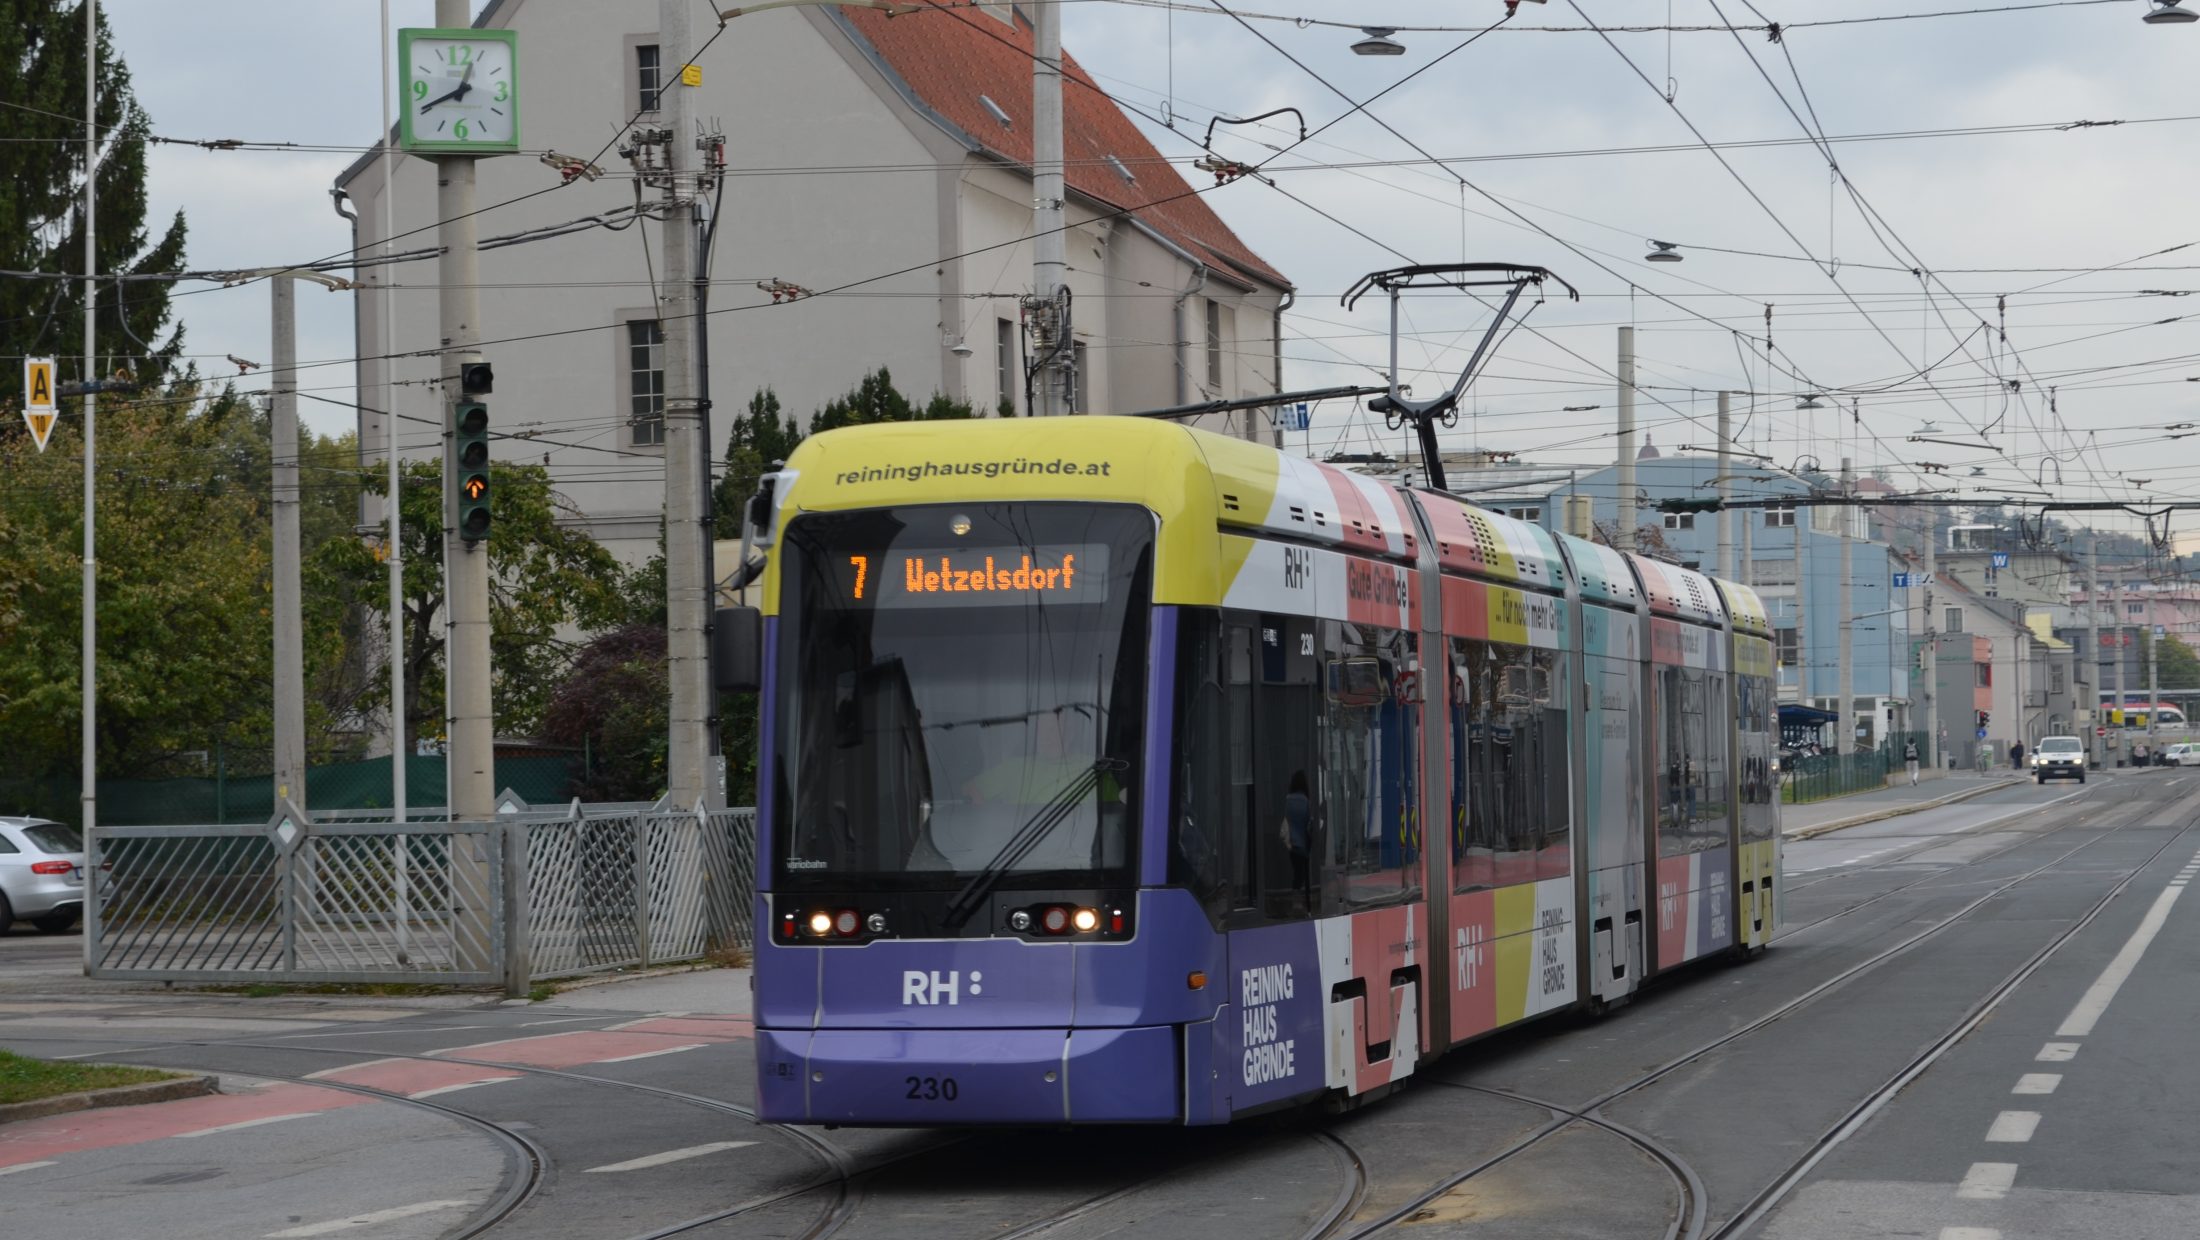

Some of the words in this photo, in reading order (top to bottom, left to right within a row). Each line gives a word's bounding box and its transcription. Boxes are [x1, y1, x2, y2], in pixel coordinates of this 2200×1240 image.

[447, 45, 473, 66] 12
[413, 80, 429, 101] 9
[494, 81, 508, 102] 3
[453, 118, 469, 139] 6
[33, 368, 49, 400] A
[36, 415, 46, 432] 10
[836, 459, 1111, 485] reininghausgründe.at
[1993, 555, 2007, 567] W
[850, 556, 867, 599] 7
[905, 554, 1074, 592] Wetzelsdorf
[1349, 560, 1371, 602] Gute
[1374, 566, 1407, 608] Gründe
[1896, 576, 1905, 585] T
[1531, 597, 1547, 630] mehr
[1301, 633, 1314, 656] 230
[1542, 907, 1563, 938] REINING
[1543, 937, 1557, 966] HAUS
[1242, 963, 1294, 1007] REINING
[1243, 1004, 1277, 1047] HAUS
[1243, 1039, 1295, 1087] GRÜNDE
[905, 1076, 958, 1101] 230
